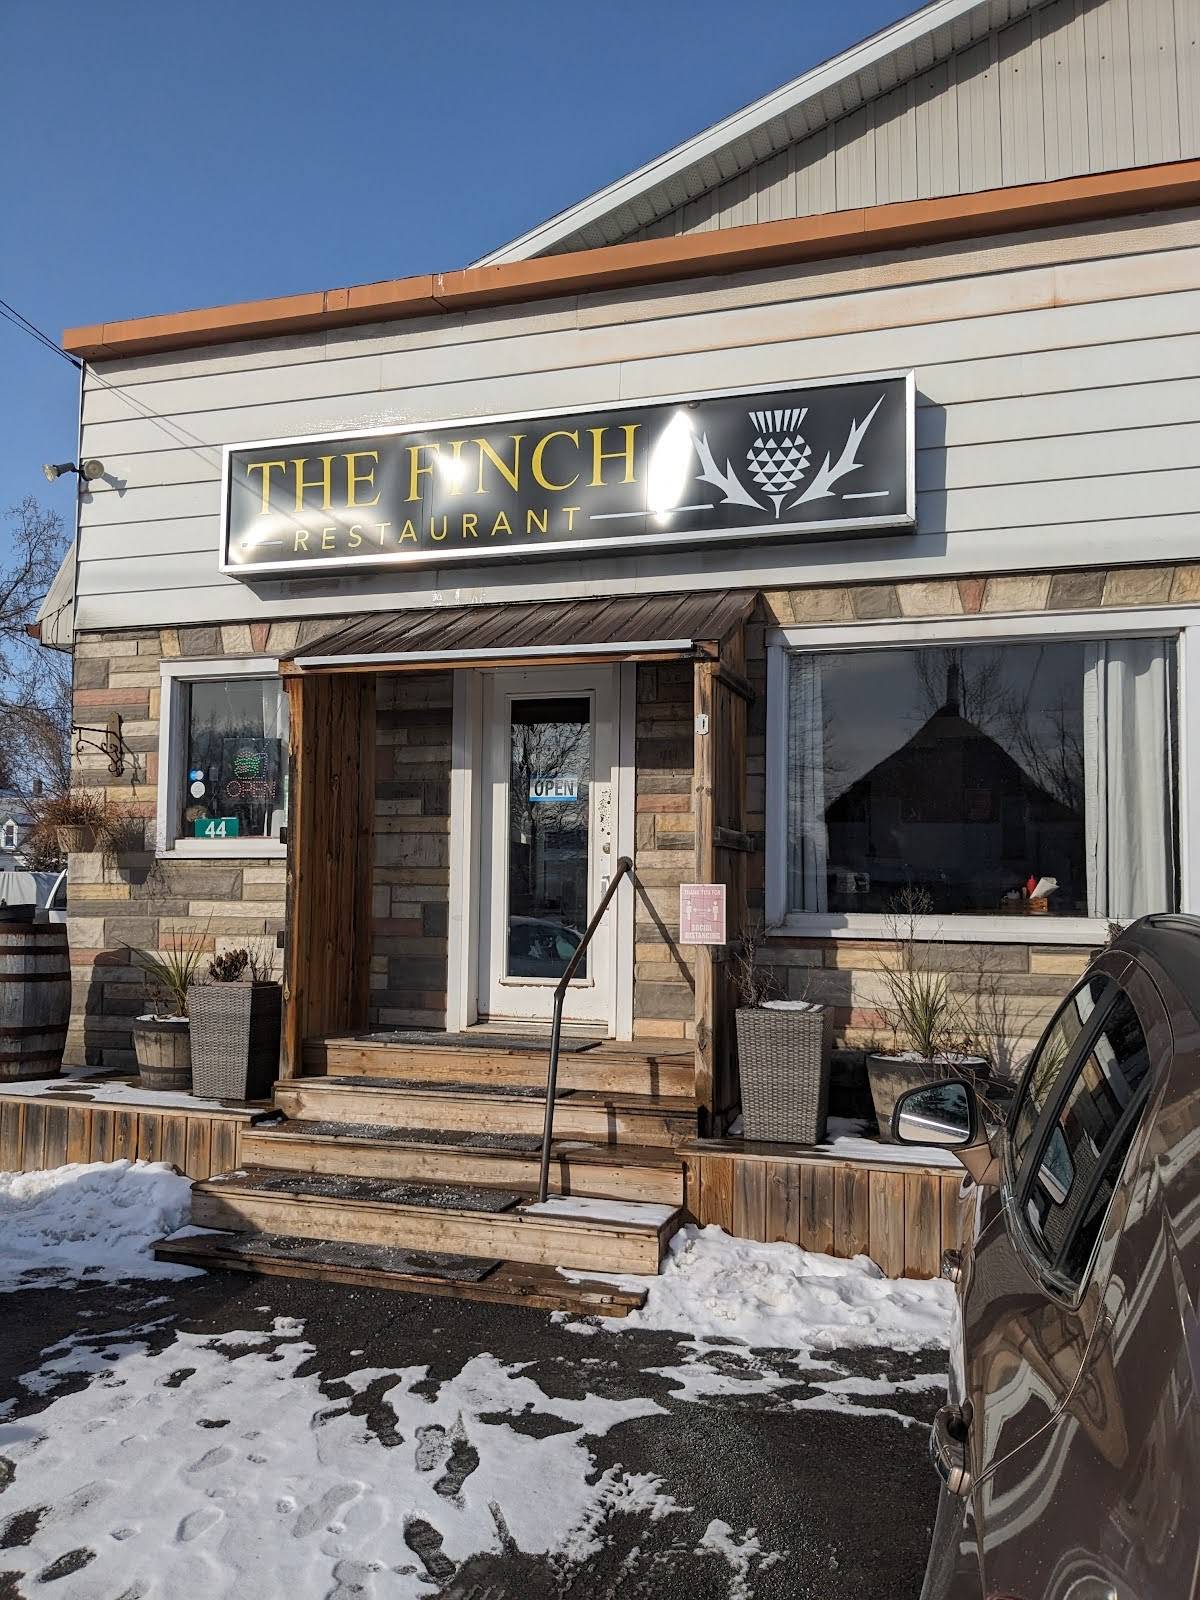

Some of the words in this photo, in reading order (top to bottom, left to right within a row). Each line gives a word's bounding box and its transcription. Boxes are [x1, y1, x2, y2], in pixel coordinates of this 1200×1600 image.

[246, 450, 382, 516] THE
[404, 423, 642, 503] FINCH
[293, 506, 581, 552] RESTAURANT
[226, 780, 276, 798] OPEN
[534, 780, 574, 796] OPEN
[204, 821, 227, 838] 44
